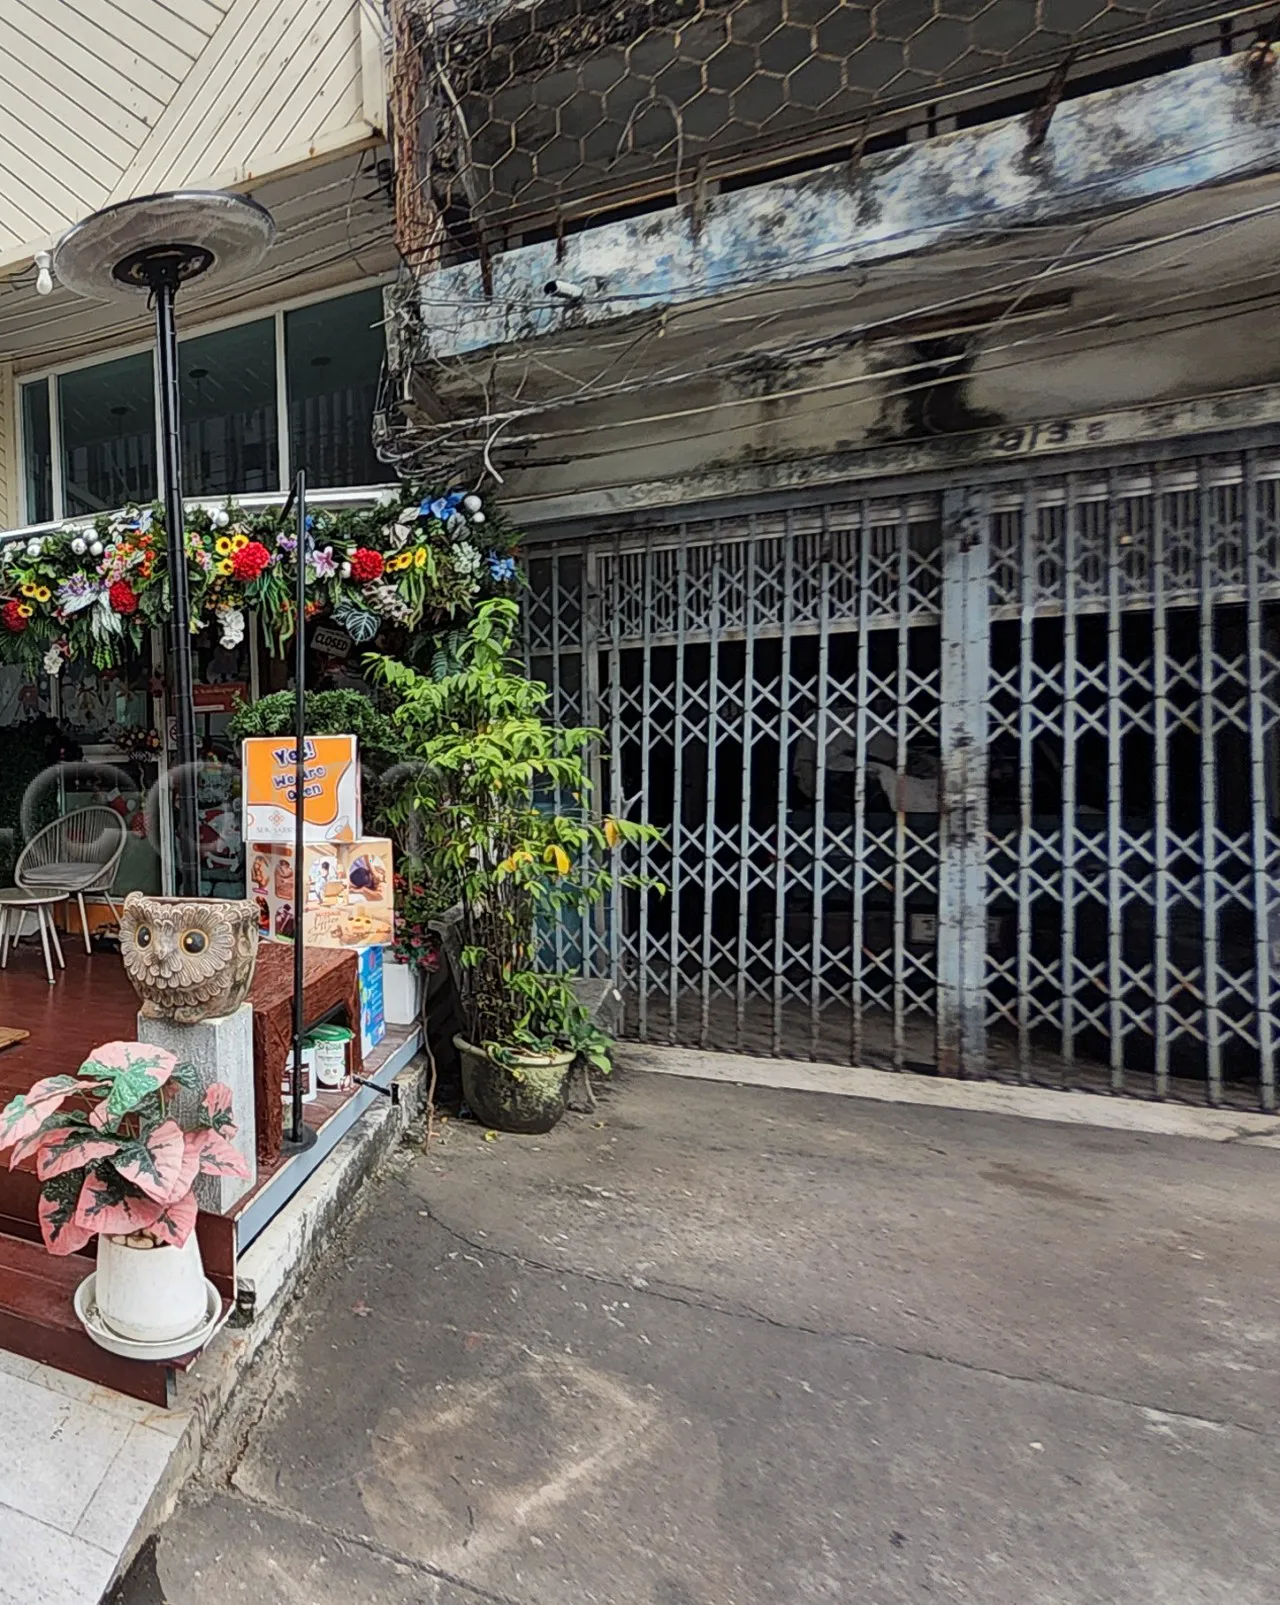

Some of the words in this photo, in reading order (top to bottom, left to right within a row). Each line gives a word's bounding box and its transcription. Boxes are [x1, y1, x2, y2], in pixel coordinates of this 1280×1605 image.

[315, 633, 348, 652] CLOSED
[273, 774, 295, 788] We
[287, 784, 322, 801] Oen
